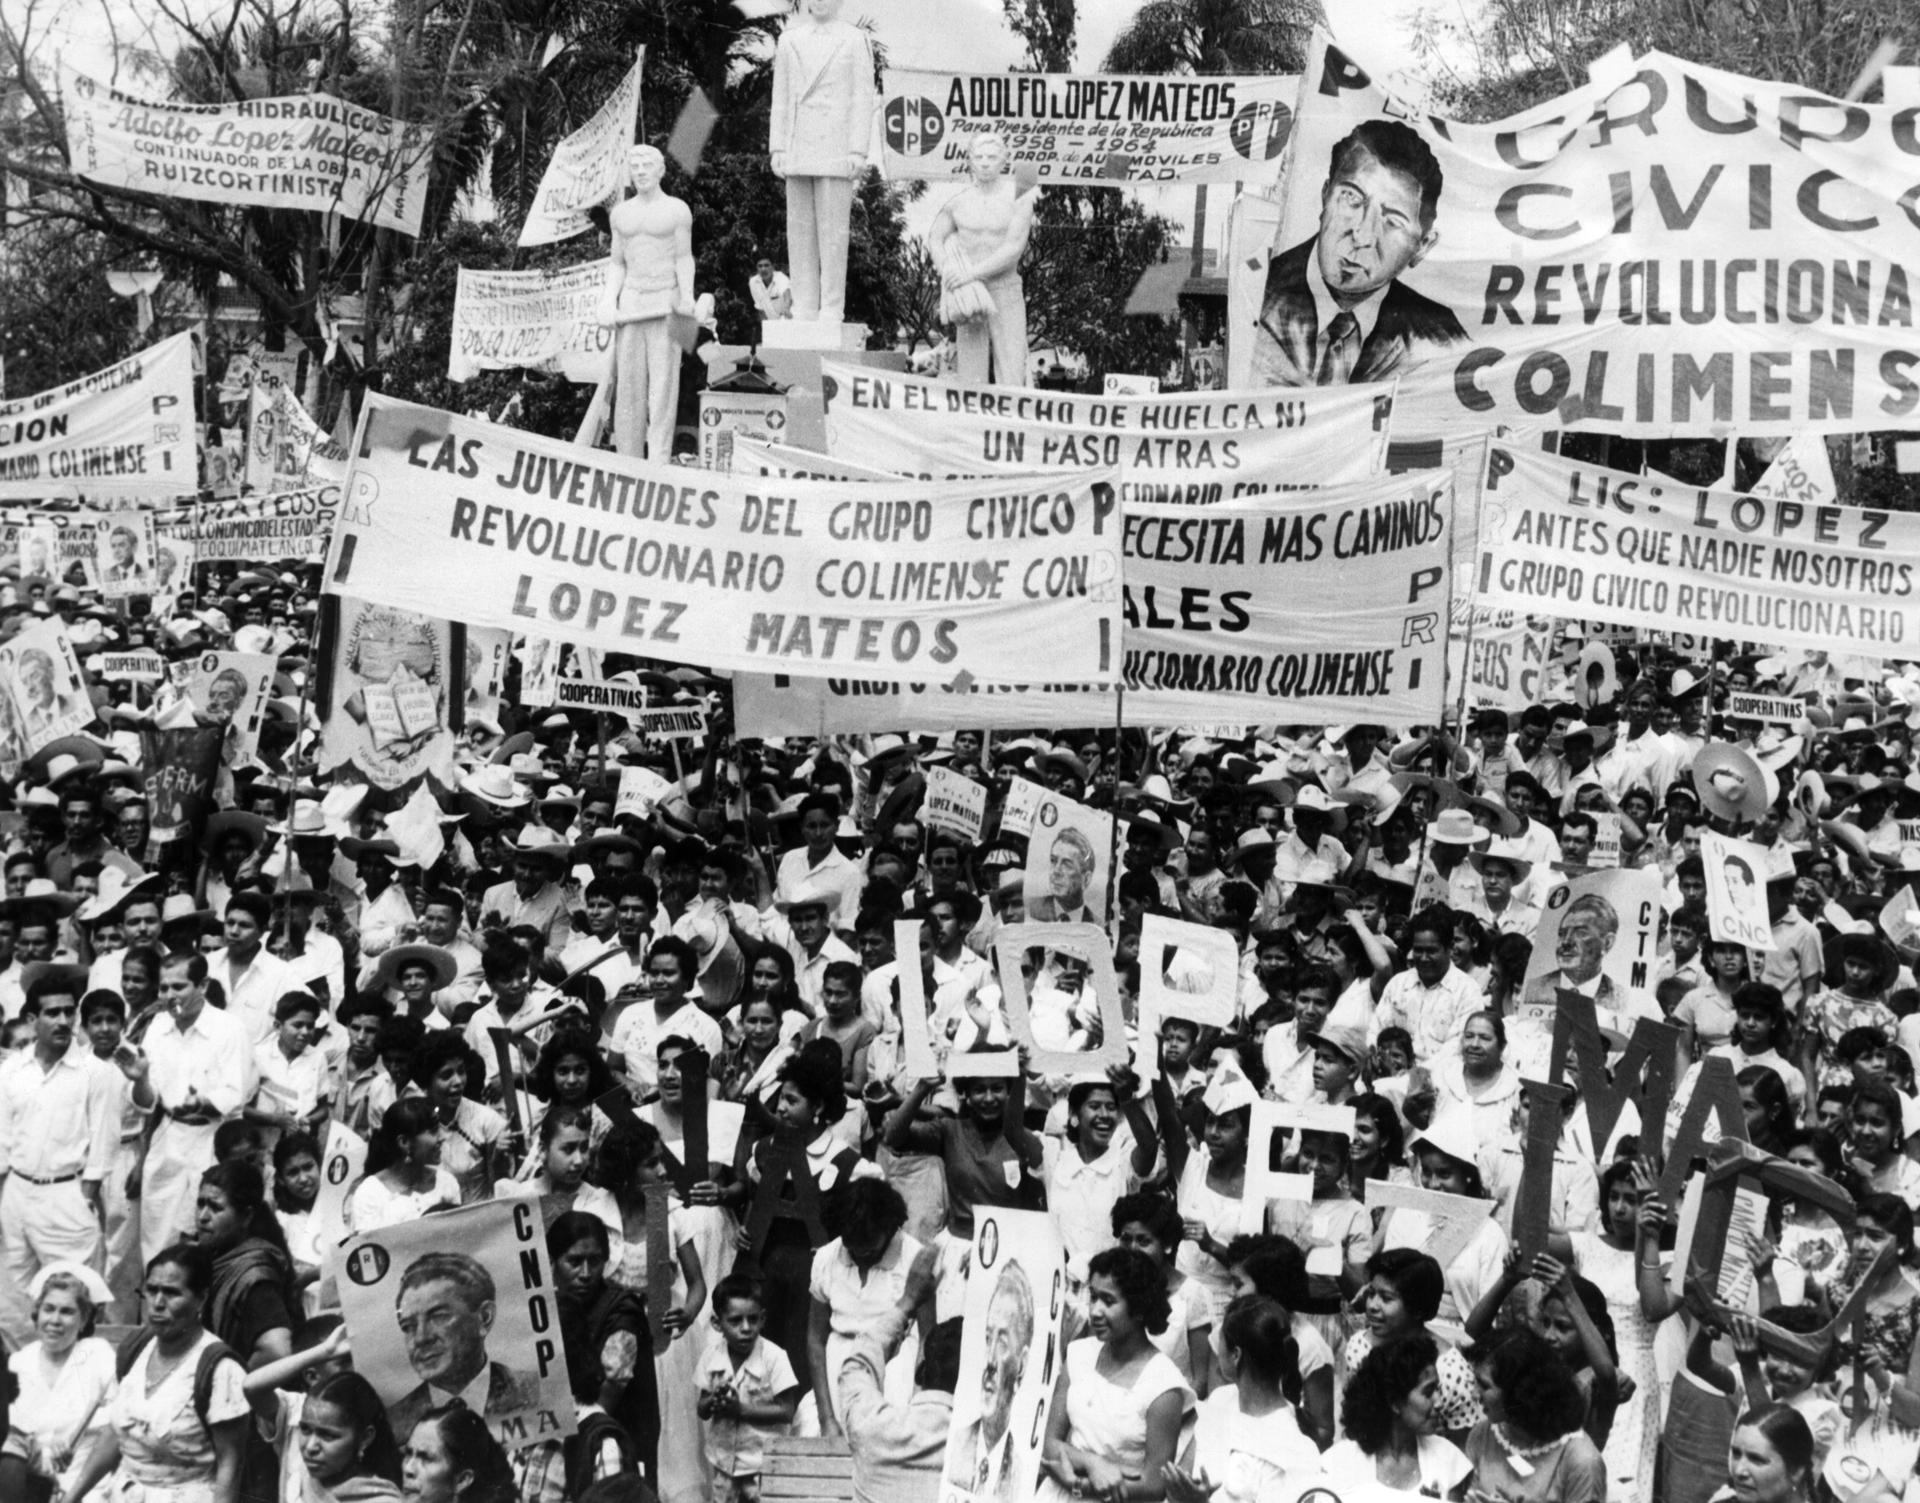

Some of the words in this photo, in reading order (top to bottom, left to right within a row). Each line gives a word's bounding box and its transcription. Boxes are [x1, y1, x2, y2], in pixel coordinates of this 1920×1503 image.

[237, 101, 393, 136] HIDRAULICOS
[945, 77, 1047, 118] ADOLFO
[1050, 80, 1124, 120] LOPEZ
[1127, 81, 1236, 122] MATEOS
[1236, 102, 1280, 139] PRI
[108, 107, 203, 145] Adolfo
[207, 121, 294, 155] Lopez
[299, 124, 396, 171] Mateos
[134, 139, 259, 169] CONTINUADOR
[267, 156, 287, 169] DE
[293, 156, 312, 172] LA
[951, 119, 991, 133] Para
[993, 119, 1085, 136] Presidente
[1088, 123, 1108, 137] de
[1111, 121, 1127, 137] la
[1130, 122, 1214, 140] Republica
[1002, 135, 1056, 150] 1958
[1094, 138, 1157, 153] 1964
[145, 159, 342, 199] RUIZCORTINISTA
[1061, 166, 1181, 181] LIBETAD.
[1082, 153, 1221, 165] AUMOVILES
[1481, 258, 1914, 326] REVOLUCIONA
[852, 377, 891, 409] EN
[904, 384, 938, 411] EL
[945, 389, 1075, 425] DERECHO
[1089, 404, 1128, 429] DE
[1275, 401, 1306, 430] NI
[1453, 346, 1920, 424] COLIMENS
[152, 395, 180, 471] PRI
[983, 430, 1035, 463] UN
[1043, 433, 1121, 466] PASO
[1133, 438, 1242, 469] ATRAS
[49, 443, 148, 479] COLIMENSE
[407, 433, 480, 478] LAS
[496, 449, 719, 530] JUVENTUDES
[740, 493, 803, 538] DEL
[828, 498, 932, 542] GRUPO
[966, 492, 1075, 540] CIVICO
[1259, 513, 1328, 564] MAS
[1334, 490, 1444, 559] CAMINOS
[1568, 470, 1664, 515] LIC:
[1693, 489, 1890, 549] LOPEZ
[450, 497, 784, 593] REVOLUCIONARIO
[815, 557, 1007, 603] COLIMENSE
[1022, 556, 1087, 600] CON
[1512, 508, 1611, 556] ANTES
[1616, 526, 1672, 567] QUE
[1678, 533, 1767, 579] NADIE
[1770, 547, 1914, 597] NOSOTROS
[512, 576, 688, 643] LOPEZ
[745, 611, 960, 665] MATEOS
[1499, 557, 1584, 602] GRUPO
[1592, 572, 1669, 615] CIVICO
[1676, 583, 1906, 645] REVOLUCIONARIO
[1402, 566, 1444, 690] PRI
[56, 635, 81, 692] CTM
[104, 656, 160, 673] COOPERATIVAS
[487, 643, 503, 697] CTM
[1266, 649, 1395, 698] COLIMENSE
[247, 674, 269, 733] CTM
[558, 682, 643, 709] COOPERATIVAS
[642, 711, 704, 733] COOPERATIVAS
[1732, 696, 1803, 719] COOPERATIVAS
[1631, 901, 1652, 989] CTM
[1722, 915, 1768, 945] CNC
[513, 1202, 556, 1379] CNOP
[1030, 1268, 1062, 1451] CNC
